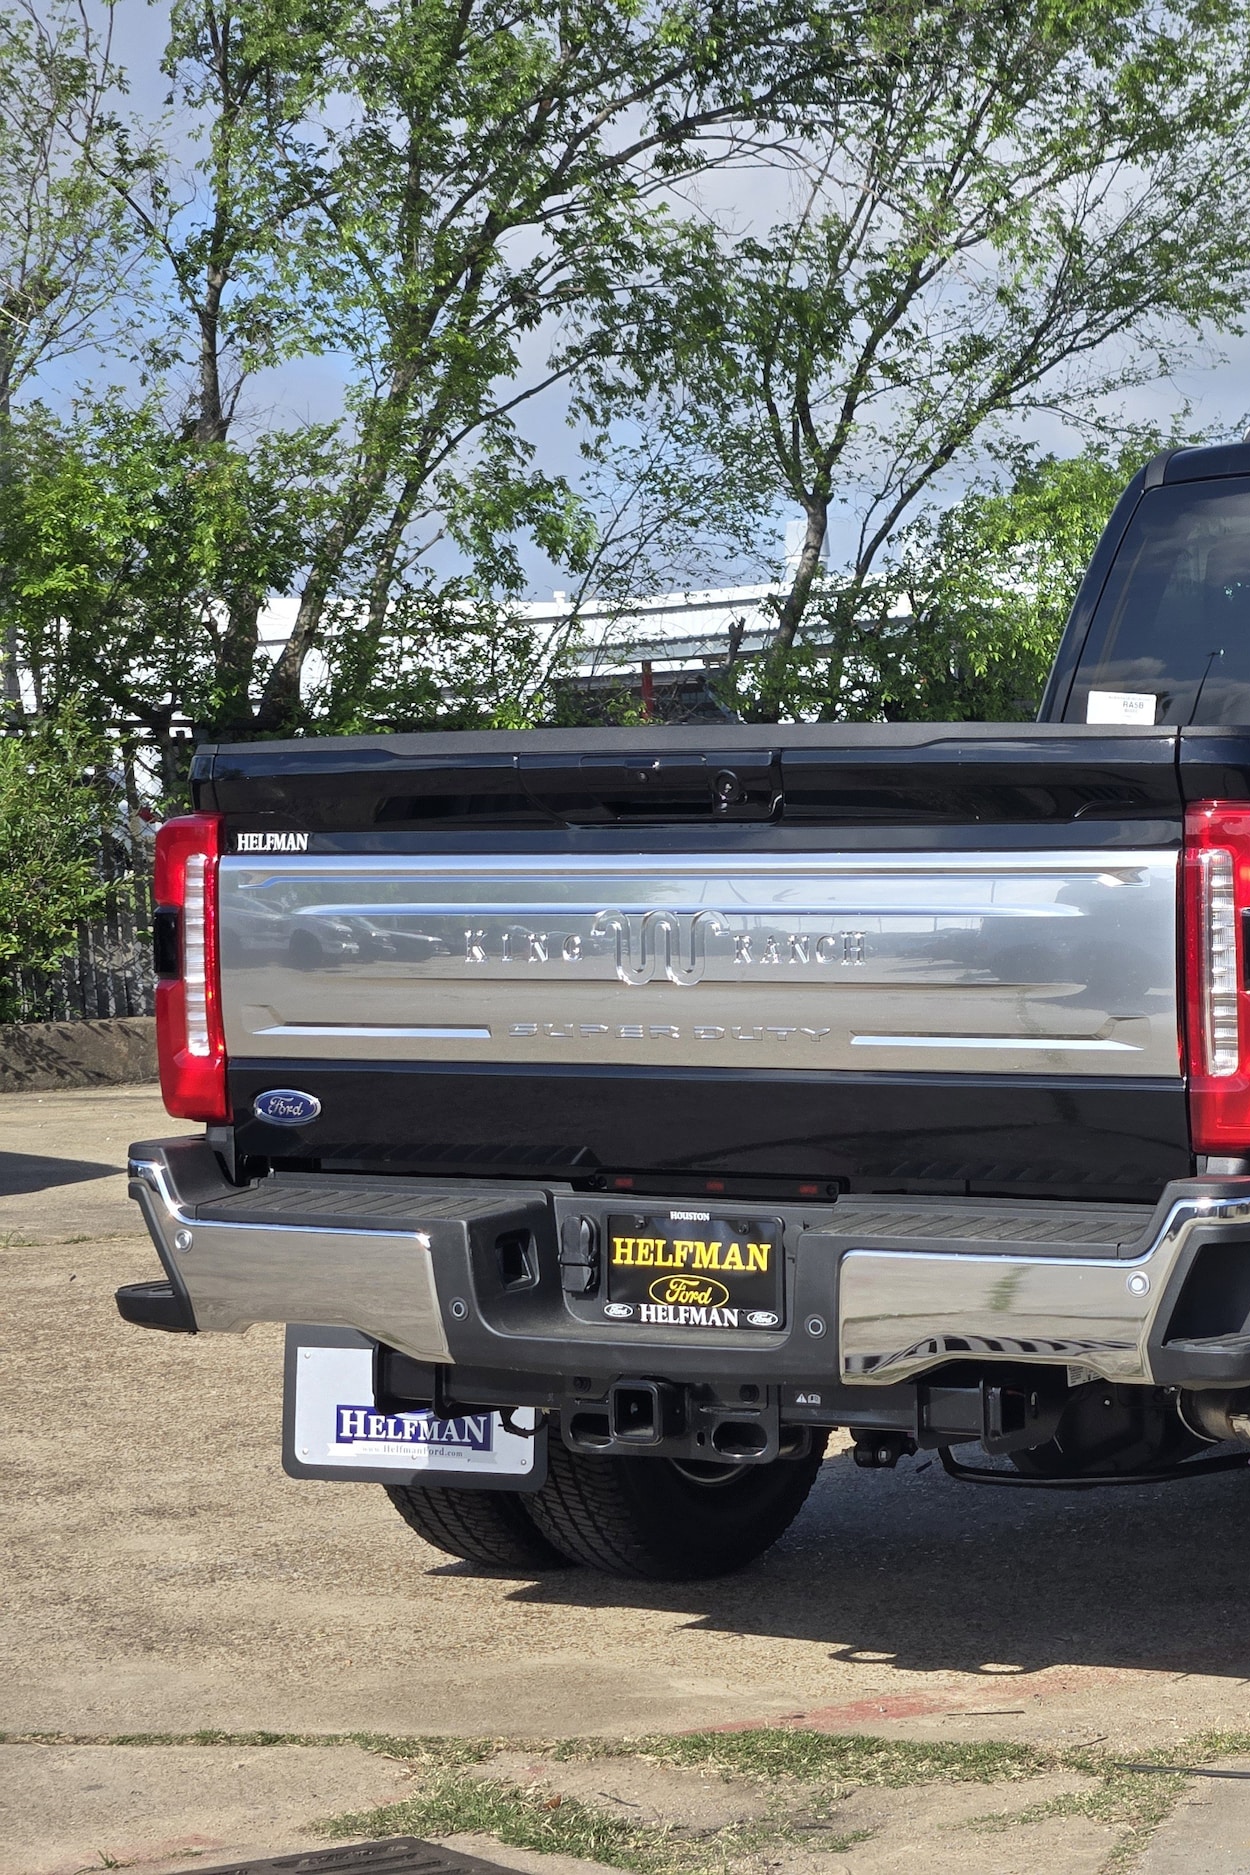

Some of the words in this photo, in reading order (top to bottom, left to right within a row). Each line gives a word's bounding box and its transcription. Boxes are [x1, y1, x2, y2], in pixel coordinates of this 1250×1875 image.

[237, 832, 308, 851] HELFMAN
[464, 928, 583, 963] KING
[733, 930, 868, 966] RANCH
[508, 1023, 681, 1040] SUPER
[694, 1025, 831, 1042] DUTY
[268, 1095, 304, 1117] Ford
[670, 1211, 710, 1221] HOUSTON
[612, 1237, 772, 1271] HELFMAN
[665, 1277, 713, 1305] Ford
[639, 1303, 739, 1327] HELFMAN
[339, 1409, 488, 1444] HELFMAN
[362, 1445, 464, 1457] www.HelfmanFord.com
